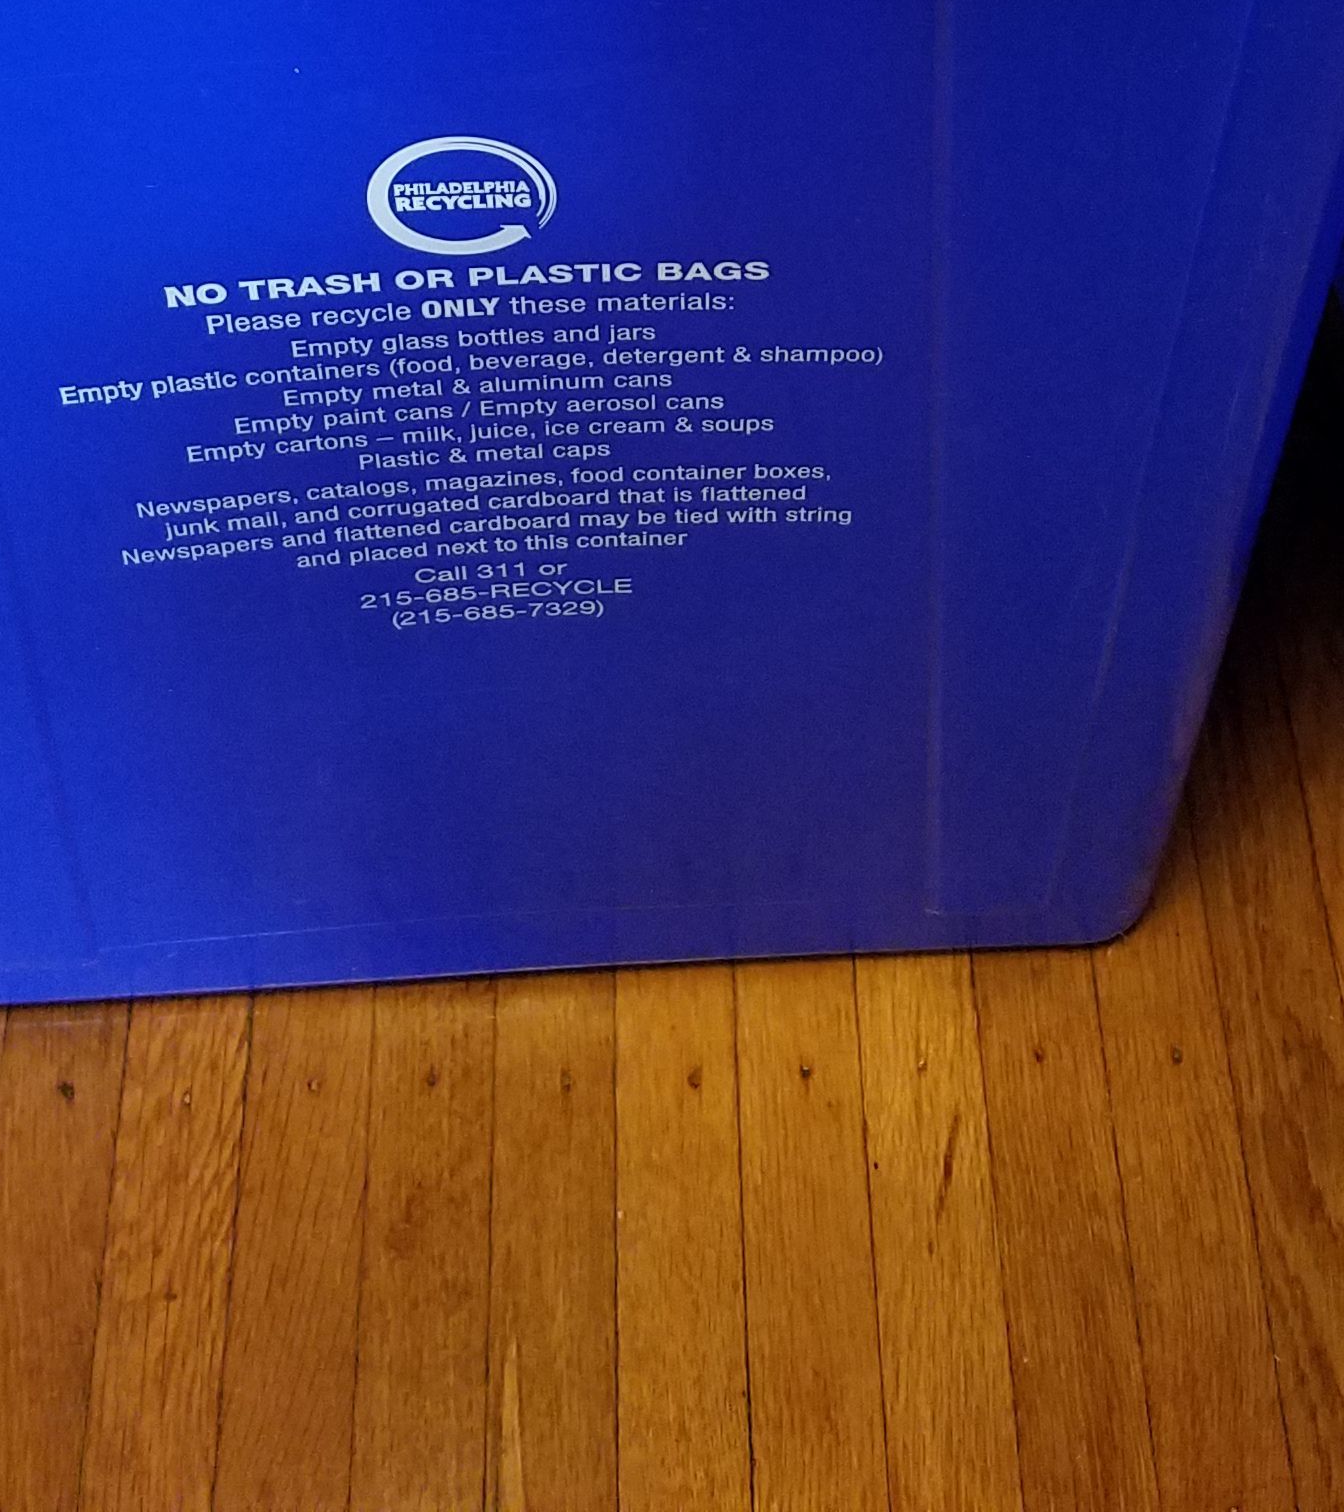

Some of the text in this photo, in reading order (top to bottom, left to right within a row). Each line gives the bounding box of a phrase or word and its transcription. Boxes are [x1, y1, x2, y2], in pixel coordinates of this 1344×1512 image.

[393, 180, 529, 196] PHILADELPHIA
[394, 193, 531, 211] RECYCLING
[163, 261, 769, 308] NO TRASH OR PLASTIC BAGS
[206, 292, 733, 334] Please recycle ONLY these materials:
[291, 324, 655, 358] Empty glass bottles and jars
[58, 345, 882, 405] Empty plastic containers (food, beverage, detergent shampoo)
[283, 374, 671, 406] Empty metal aluminum cans
[234, 394, 723, 434] Empty paint cans Empty aerosol cans
[186, 418, 773, 462] Empty cartons milk, juice, ice cream soups
[359, 443, 610, 469] Plastic metal caps
[136, 464, 830, 518] Newspapers, catalogs, magazines, food container boxes,
[165, 485, 805, 541] junk mail, and corrugated cardboard that is flattened
[121, 506, 851, 565] Newspapers and flattened cardboard may be tied with string
[296, 531, 687, 567] and placed next to this container
[414, 562, 567, 582] Call 311 or
[360, 578, 632, 608] 215-685-RECYCLE
[392, 599, 603, 629] (215-685-7329)
